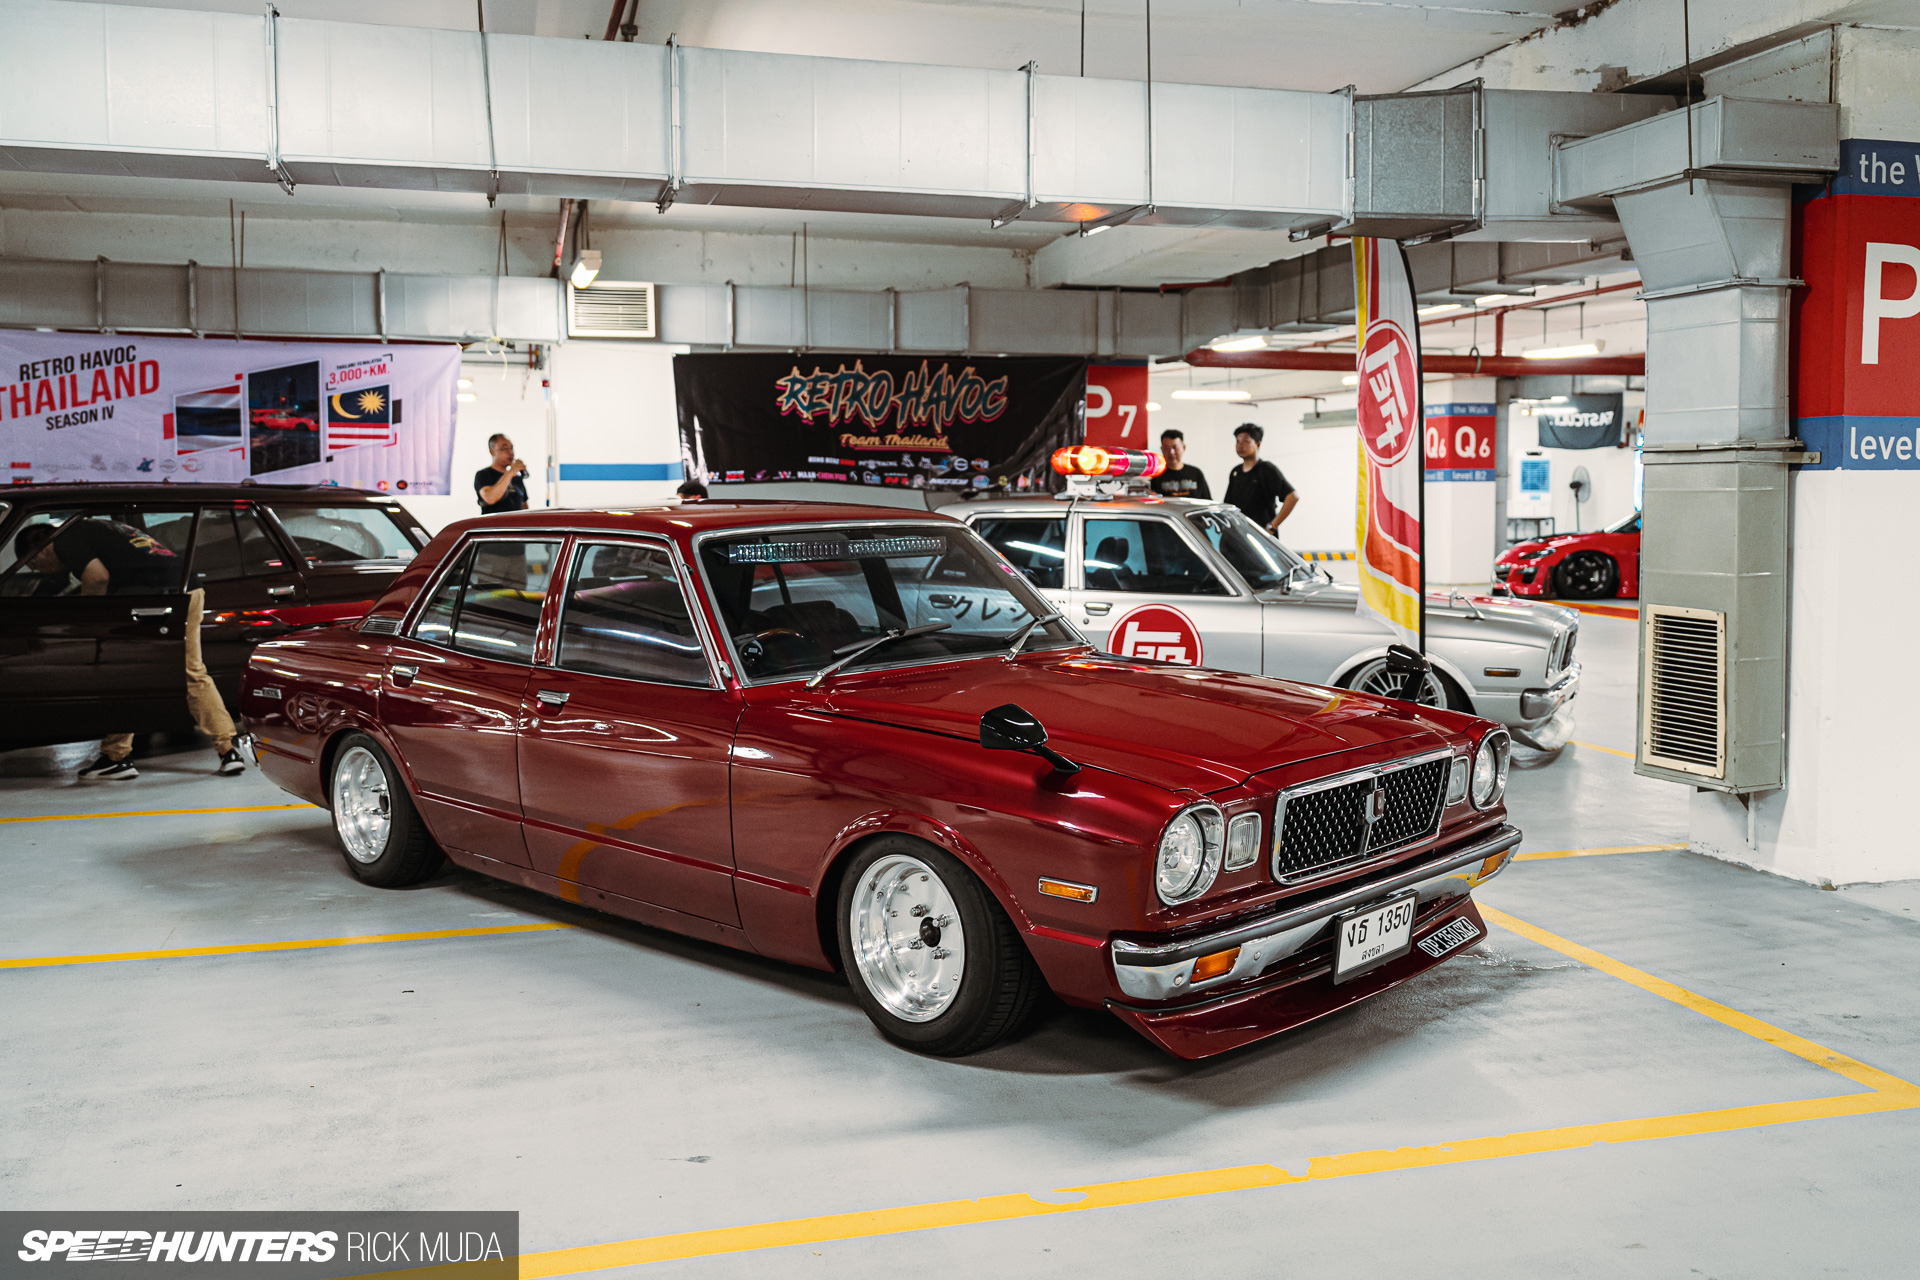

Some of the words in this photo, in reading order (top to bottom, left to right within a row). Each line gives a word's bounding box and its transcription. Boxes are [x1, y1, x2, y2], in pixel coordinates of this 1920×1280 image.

[1859, 152, 1905, 185] the
[1861, 242, 1920, 365] P
[19, 355, 75, 382] RETRO
[80, 345, 137, 371] HAVOC
[776, 359, 894, 432] RETRO
[891, 359, 1008, 438] HAVOC
[46, 408, 98, 431] SEASON
[102, 405, 115, 421] IV
[840, 433, 880, 446] Team
[884, 434, 949, 448] Thailand
[1850, 427, 1920, 460] level
[1378, 902, 1411, 936] 1350
[1361, 944, 1385, 960] สงขลา
